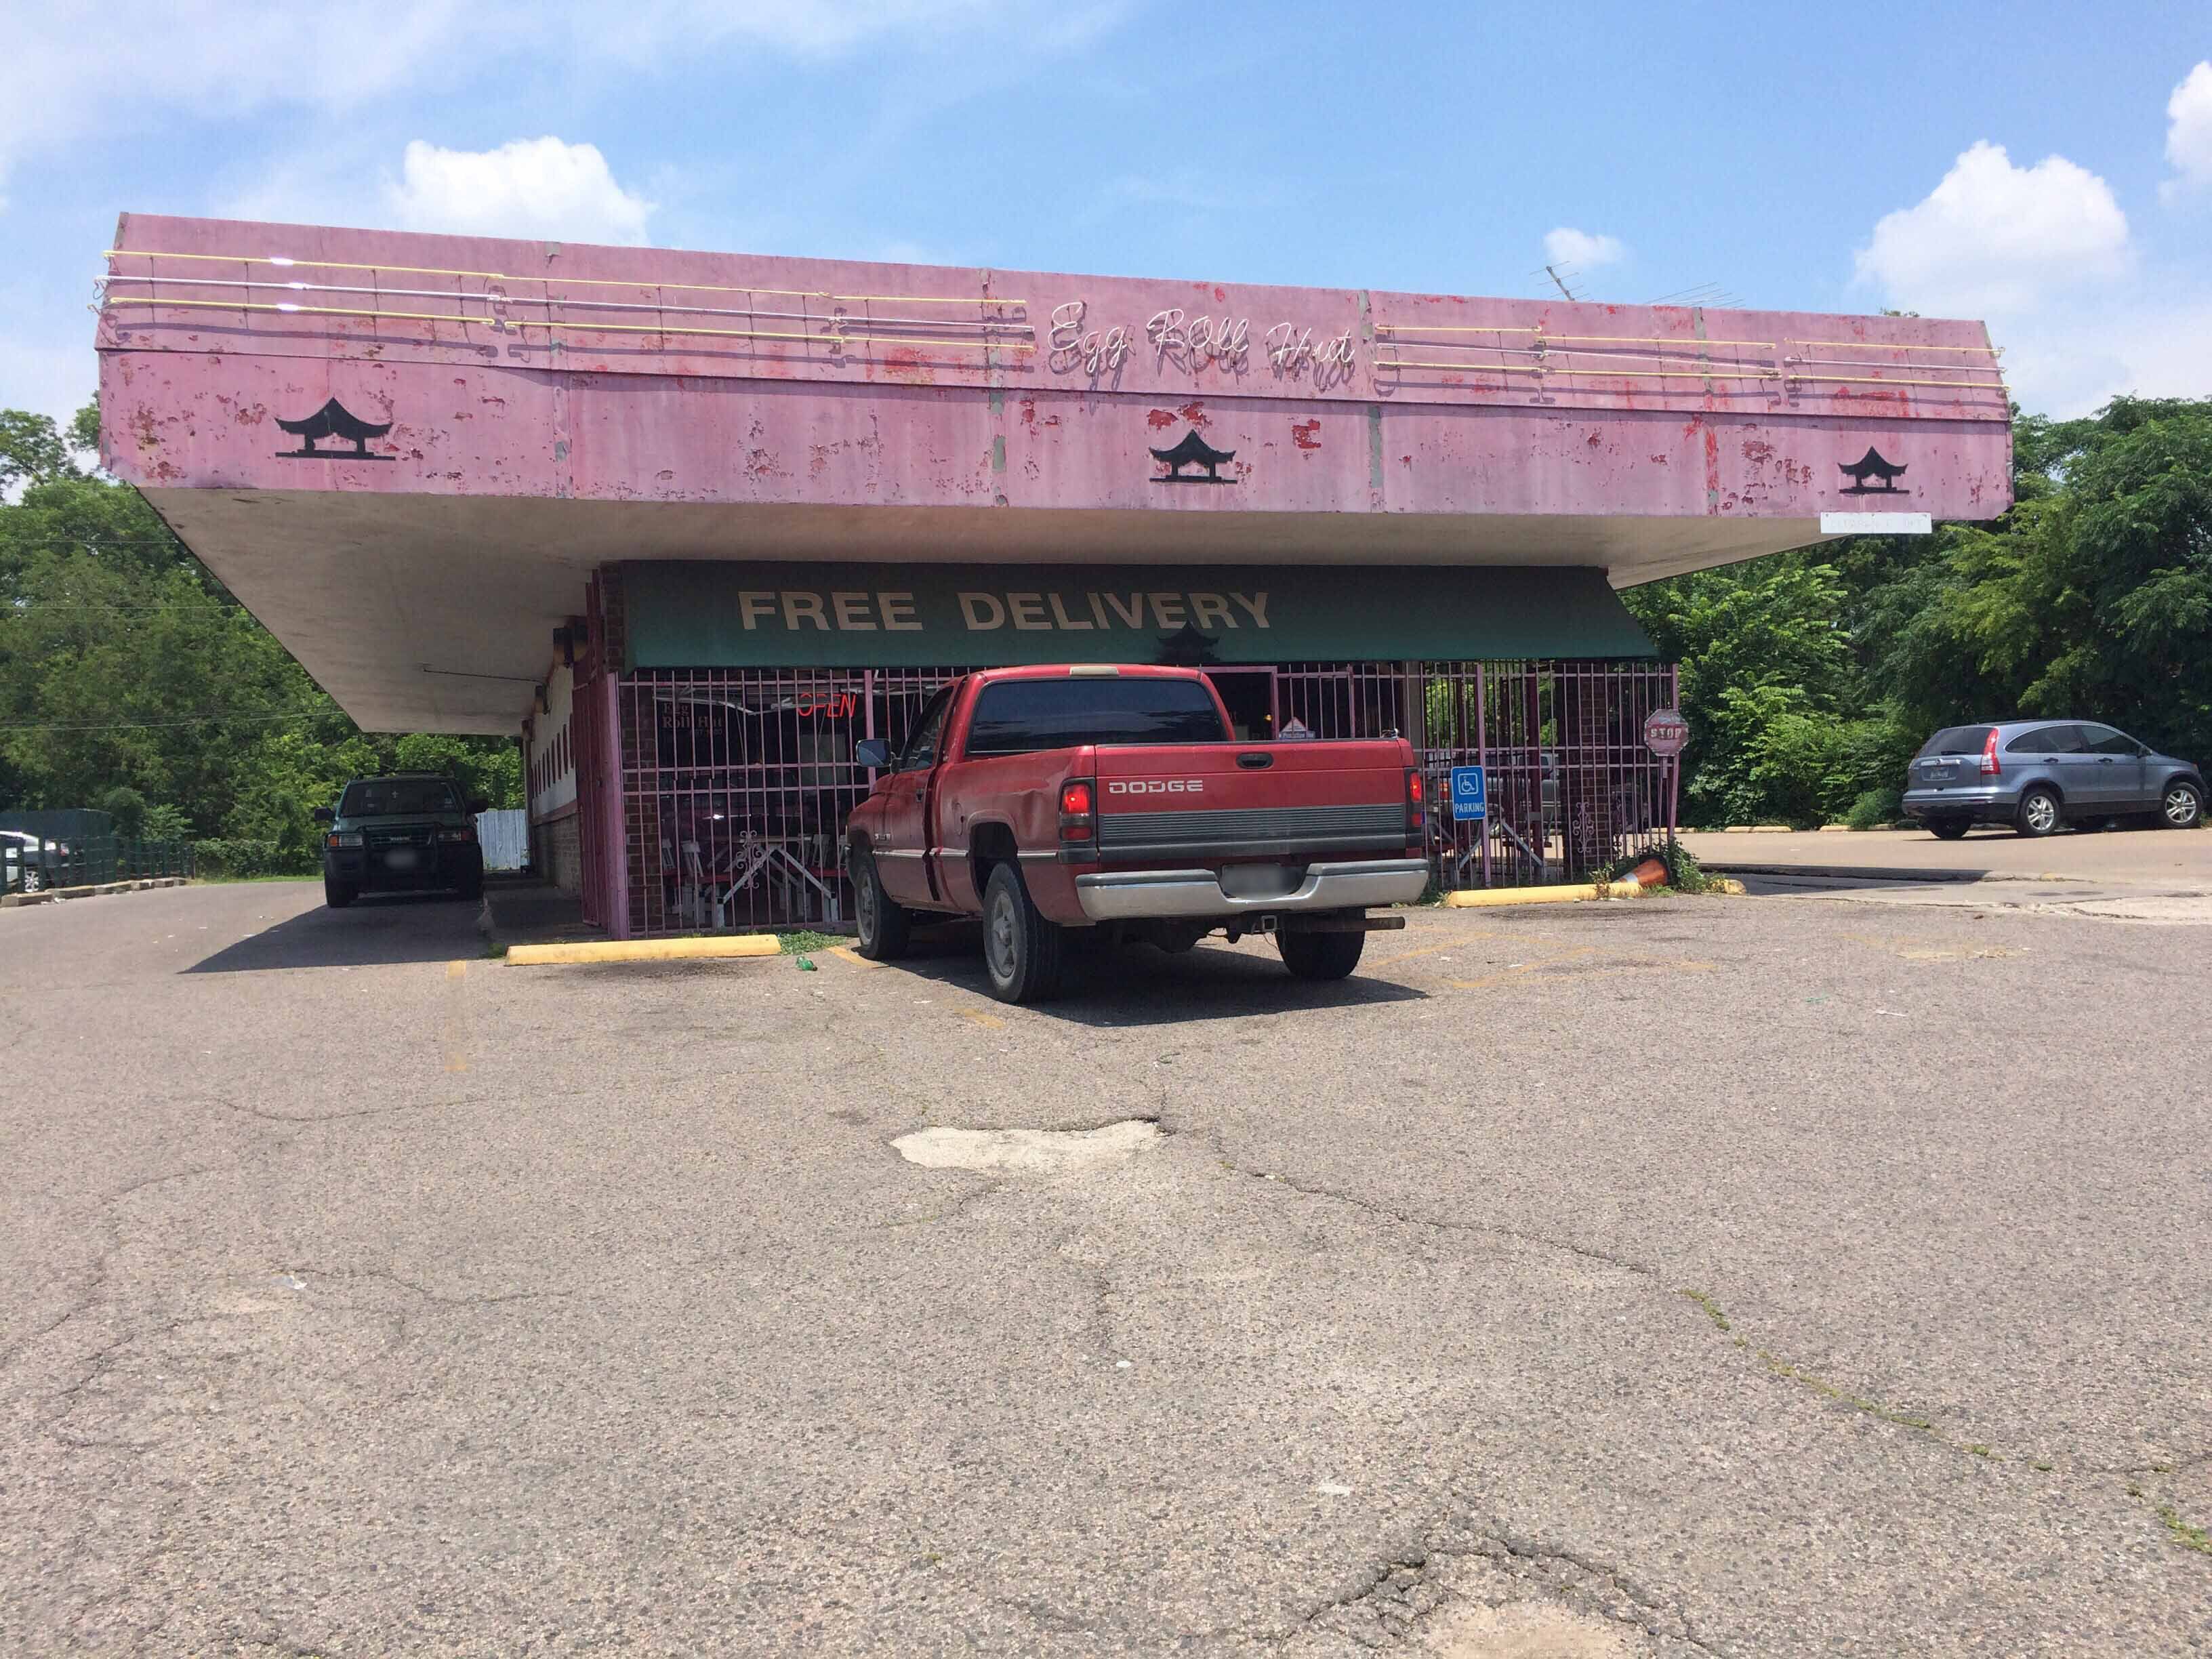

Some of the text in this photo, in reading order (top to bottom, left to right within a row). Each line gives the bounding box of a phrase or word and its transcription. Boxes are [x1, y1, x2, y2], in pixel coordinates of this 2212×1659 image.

[1048, 302, 1127, 373] Egg
[1267, 323, 1355, 365] Hut
[737, 591, 1271, 631] FREE DELIVERY
[798, 692, 857, 718] OPEN
[1650, 727, 1682, 739] STOP
[1109, 779, 1204, 794] DODGE
[1454, 802, 1485, 814] PARKING
